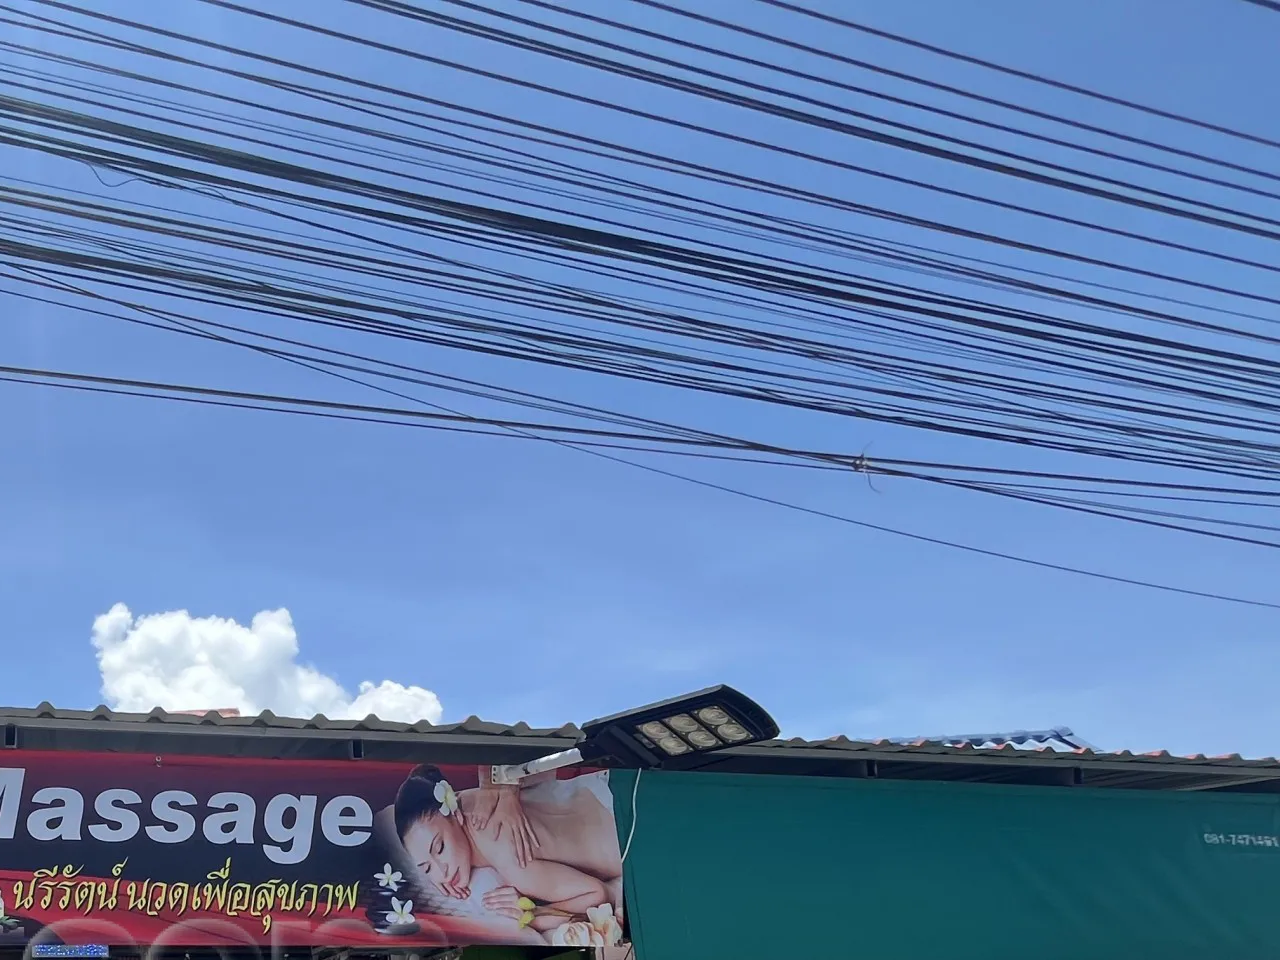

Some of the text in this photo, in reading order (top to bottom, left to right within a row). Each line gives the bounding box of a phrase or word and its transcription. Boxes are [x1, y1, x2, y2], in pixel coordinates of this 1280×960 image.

[13, 857, 359, 935] นรีรัตน์ นวดเพื่อสุขภาพ
